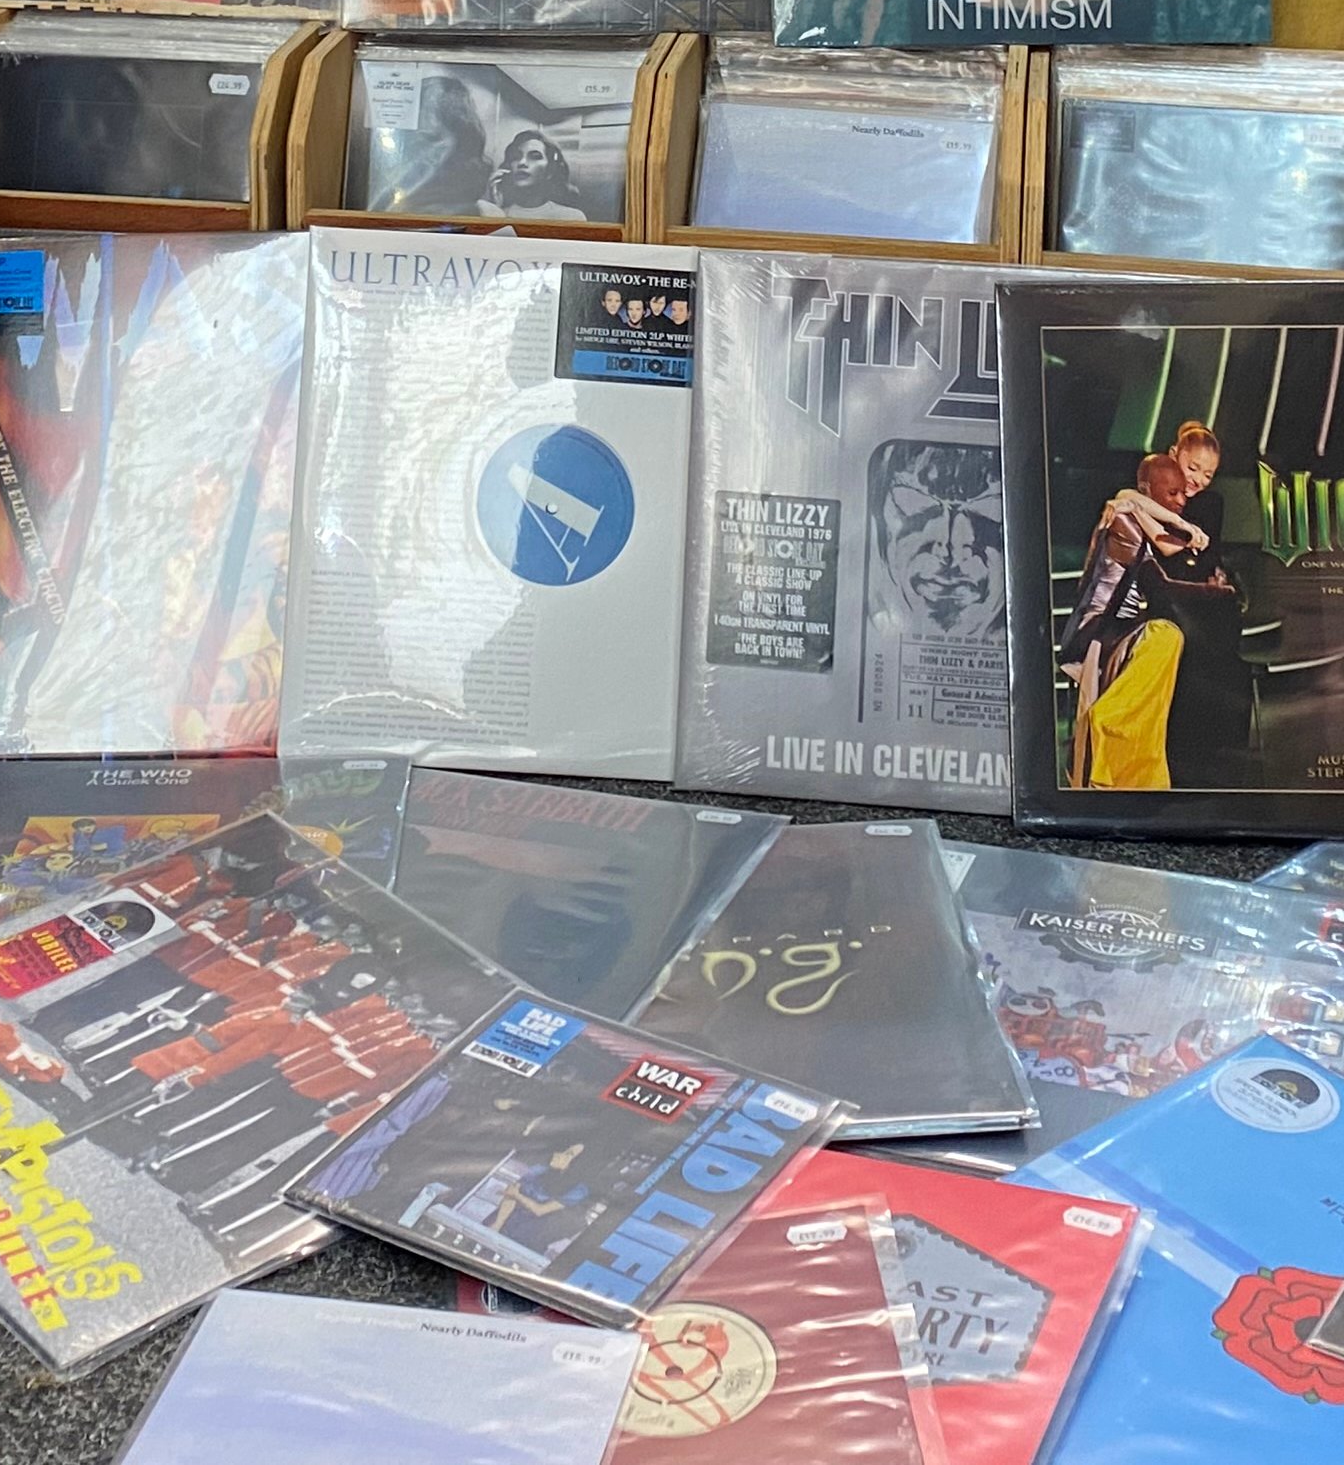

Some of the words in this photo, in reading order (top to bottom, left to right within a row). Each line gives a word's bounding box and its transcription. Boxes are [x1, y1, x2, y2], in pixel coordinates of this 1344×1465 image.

[851, 125, 881, 137] Nearly
[882, 127, 925, 138] Daffodils
[330, 250, 554, 295] ULTRAVOX
[579, 270, 642, 286] ULTRAVOX
[646, 275, 672, 288] THE
[574, 325, 610, 337] LIMITED
[610, 328, 648, 340] EDITION
[772, 276, 945, 438] THIN
[726, 498, 769, 523] THIN
[775, 502, 829, 527] LIZZY
[721, 521, 740, 533] LIVE
[741, 523, 753, 534] IN
[755, 524, 805, 539] CLEVELAND
[807, 528, 833, 541] 1976
[726, 562, 743, 574] THE
[745, 564, 785, 578] CLASSIC
[1301, 560, 1327, 569] ONE
[734, 575, 742, 585] A
[744, 576, 784, 589] CLASSIC
[785, 578, 813, 591] SHOW
[1321, 587, 1344, 595] THE
[35, 565, 67, 626] CIRCUS
[742, 590, 755, 602] ON
[785, 594, 803, 605] FOR
[738, 601, 755, 613] THE
[756, 602, 783, 615] FIRST
[785, 605, 807, 617] TIME
[743, 617, 804, 633] TRANSPARENT
[805, 622, 831, 635] VINYL
[734, 642, 760, 655] BACK
[761, 645, 772, 656] IN
[759, 634, 784, 647] BOYS
[785, 637, 805, 649] ARE
[941, 656, 964, 668] LIZZY
[967, 658, 975, 669] &
[978, 660, 1004, 671] PARIS
[908, 704, 924, 719] 11
[766, 736, 825, 772] LIVE
[833, 739, 865, 776] IN
[872, 743, 1011, 788] CLEVELAN
[91, 768, 135, 779] THE
[139, 768, 193, 778] WHO
[102, 777, 150, 786] Quick
[154, 776, 190, 785] One
[1028, 911, 1114, 935] KAISER
[1119, 925, 1207, 952] CHIEFS
[31, 929, 79, 974] JUBILEE
[635, 1061, 703, 1096] WAR
[615, 1086, 681, 1115] child
[681, 1082, 822, 1194] BAD
[565, 1189, 717, 1305] LIFE
[906, 1280, 997, 1308] AST
[419, 1321, 463, 1338] Nearly
[465, 1327, 528, 1344] Daffodils
[918, 1307, 1010, 1356] RTY
